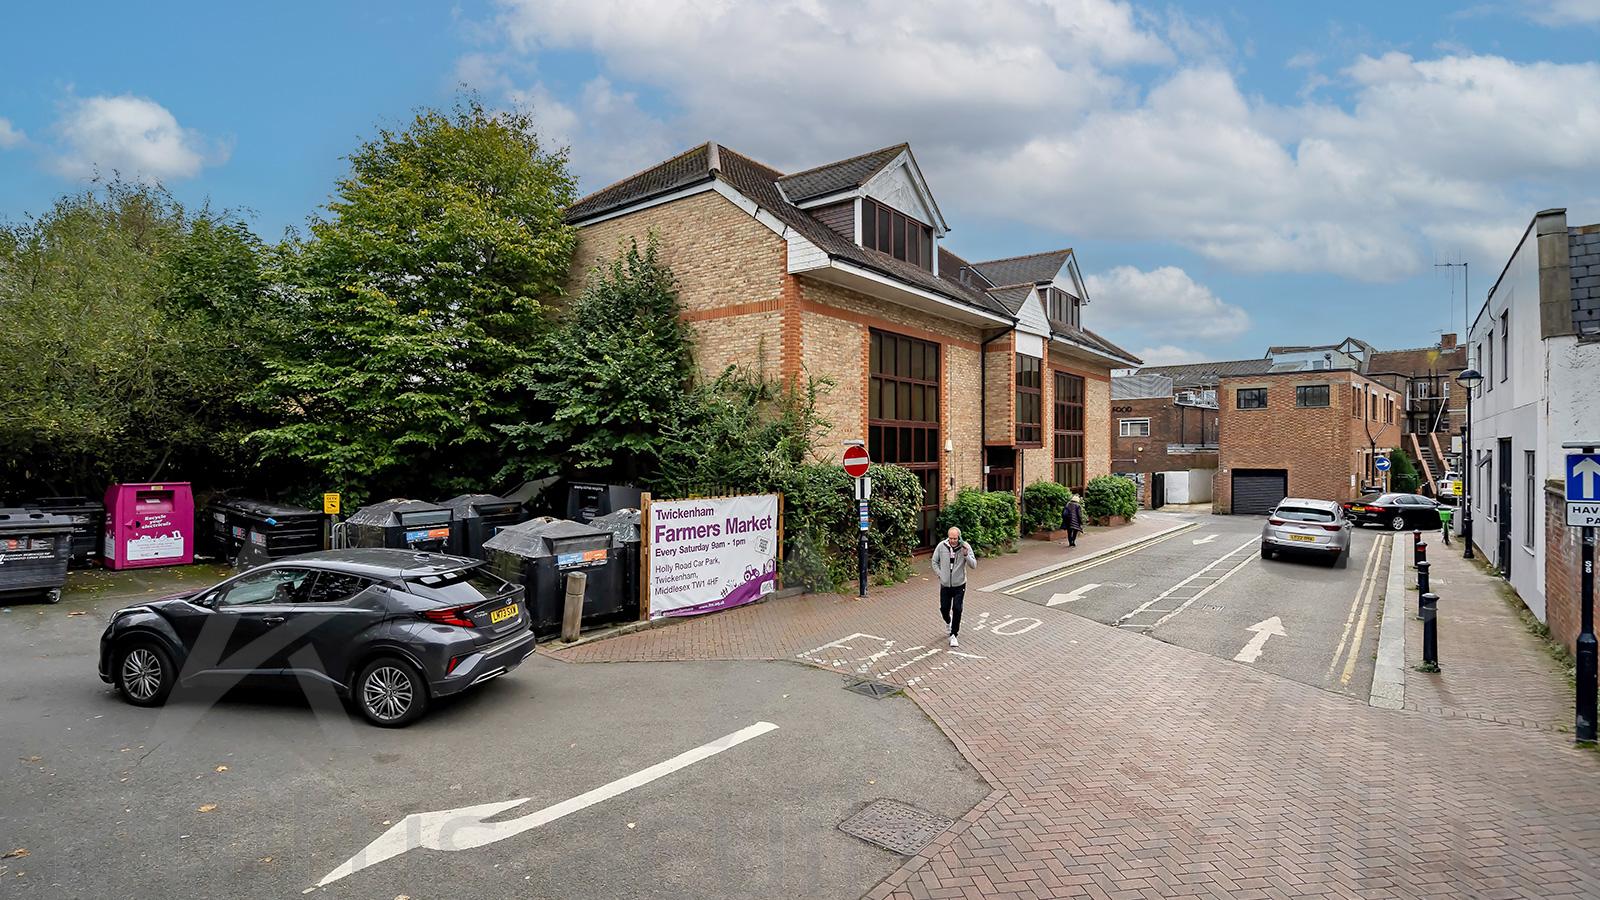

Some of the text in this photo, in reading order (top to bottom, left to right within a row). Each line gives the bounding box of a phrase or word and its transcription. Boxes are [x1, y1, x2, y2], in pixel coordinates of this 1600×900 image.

[655, 507, 714, 520] Twickenham
[655, 515, 772, 543] Farmers Market
[655, 547, 678, 558] Every
[679, 543, 710, 555] Saturday
[711, 541, 726, 550] 9am
[732, 538, 746, 547] 1pm
[655, 556, 721, 574] Holly Road Car Park,
[654, 577, 719, 596] Middlesex TW1 4HF
[655, 571, 699, 584] Twickenham,
